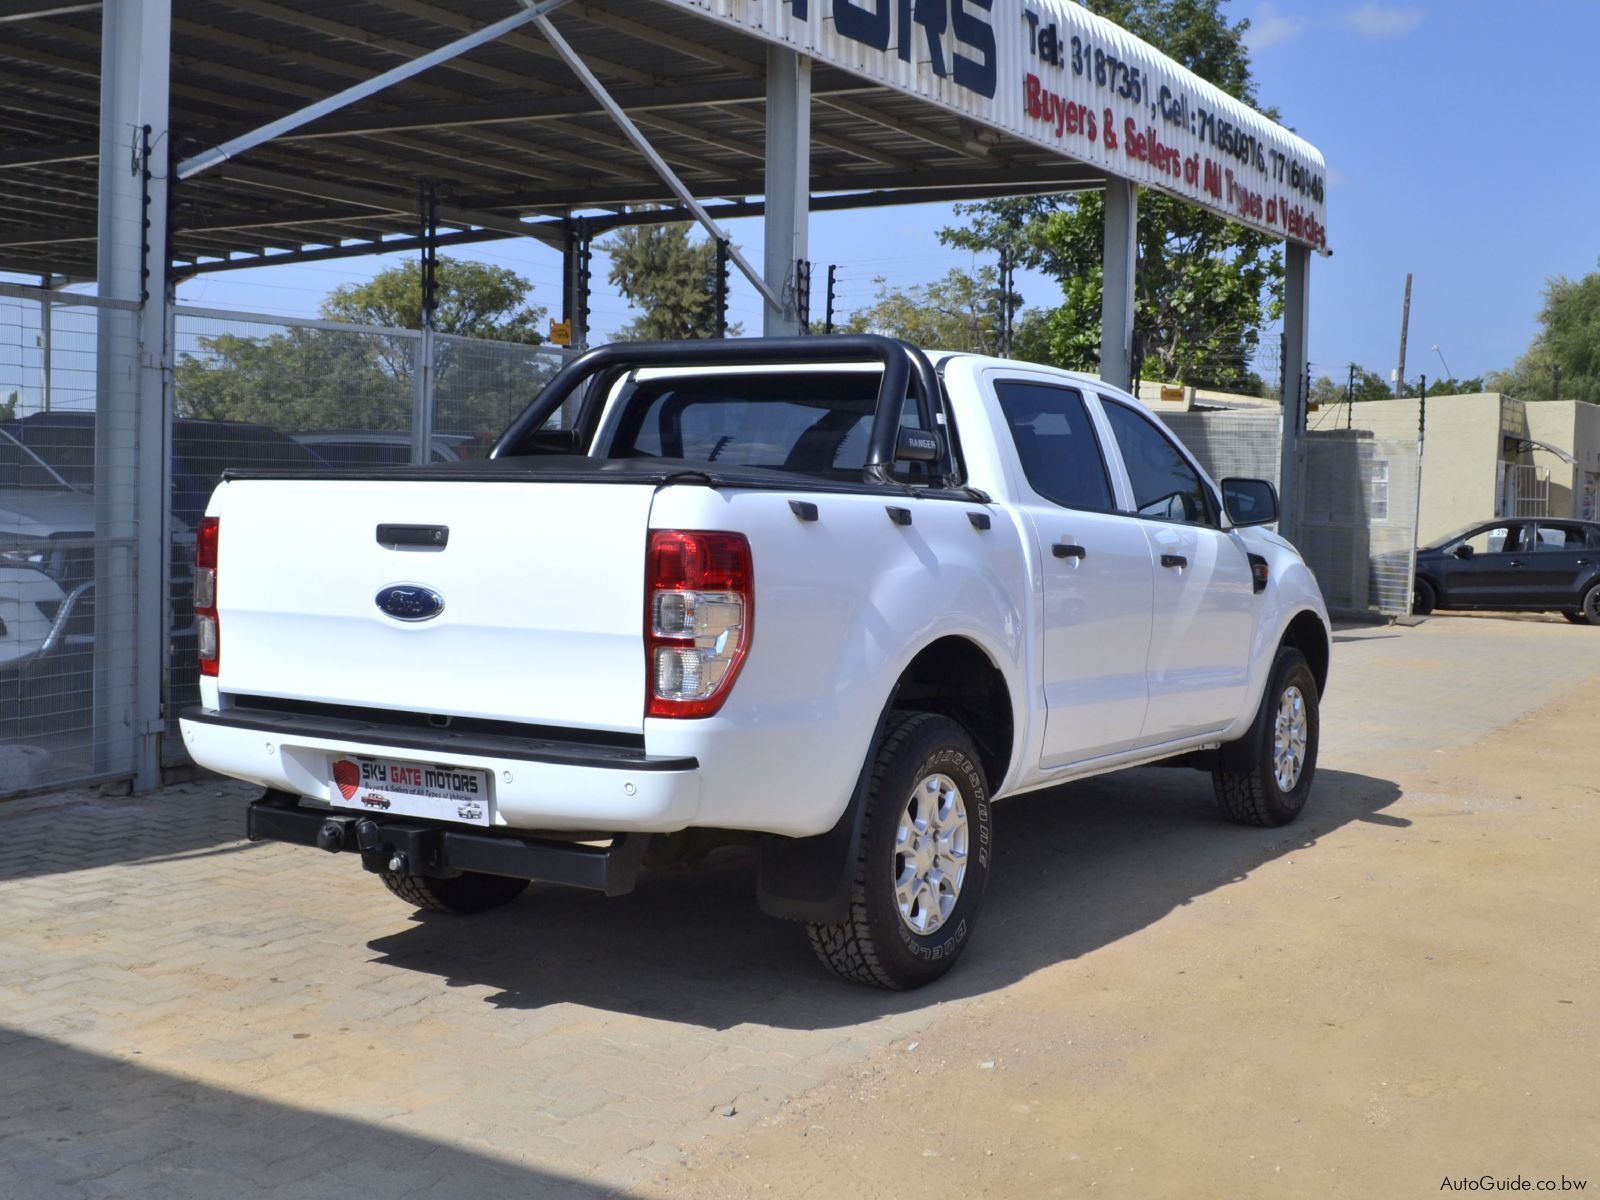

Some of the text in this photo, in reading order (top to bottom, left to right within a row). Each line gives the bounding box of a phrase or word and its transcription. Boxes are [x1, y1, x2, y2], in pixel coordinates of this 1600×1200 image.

[1025, 8, 1064, 69] Tel:
[1159, 84, 1196, 135] Cell:
[1026, 72, 1326, 248] Buyers & Sellers of All Types of Vehicles
[909, 438, 936, 449] RANGER
[362, 763, 478, 793] SKY GATE MOTORS
[365, 782, 383, 791] Buyers
[390, 785, 409, 794] Sellers
[425, 789, 441, 798] Types
